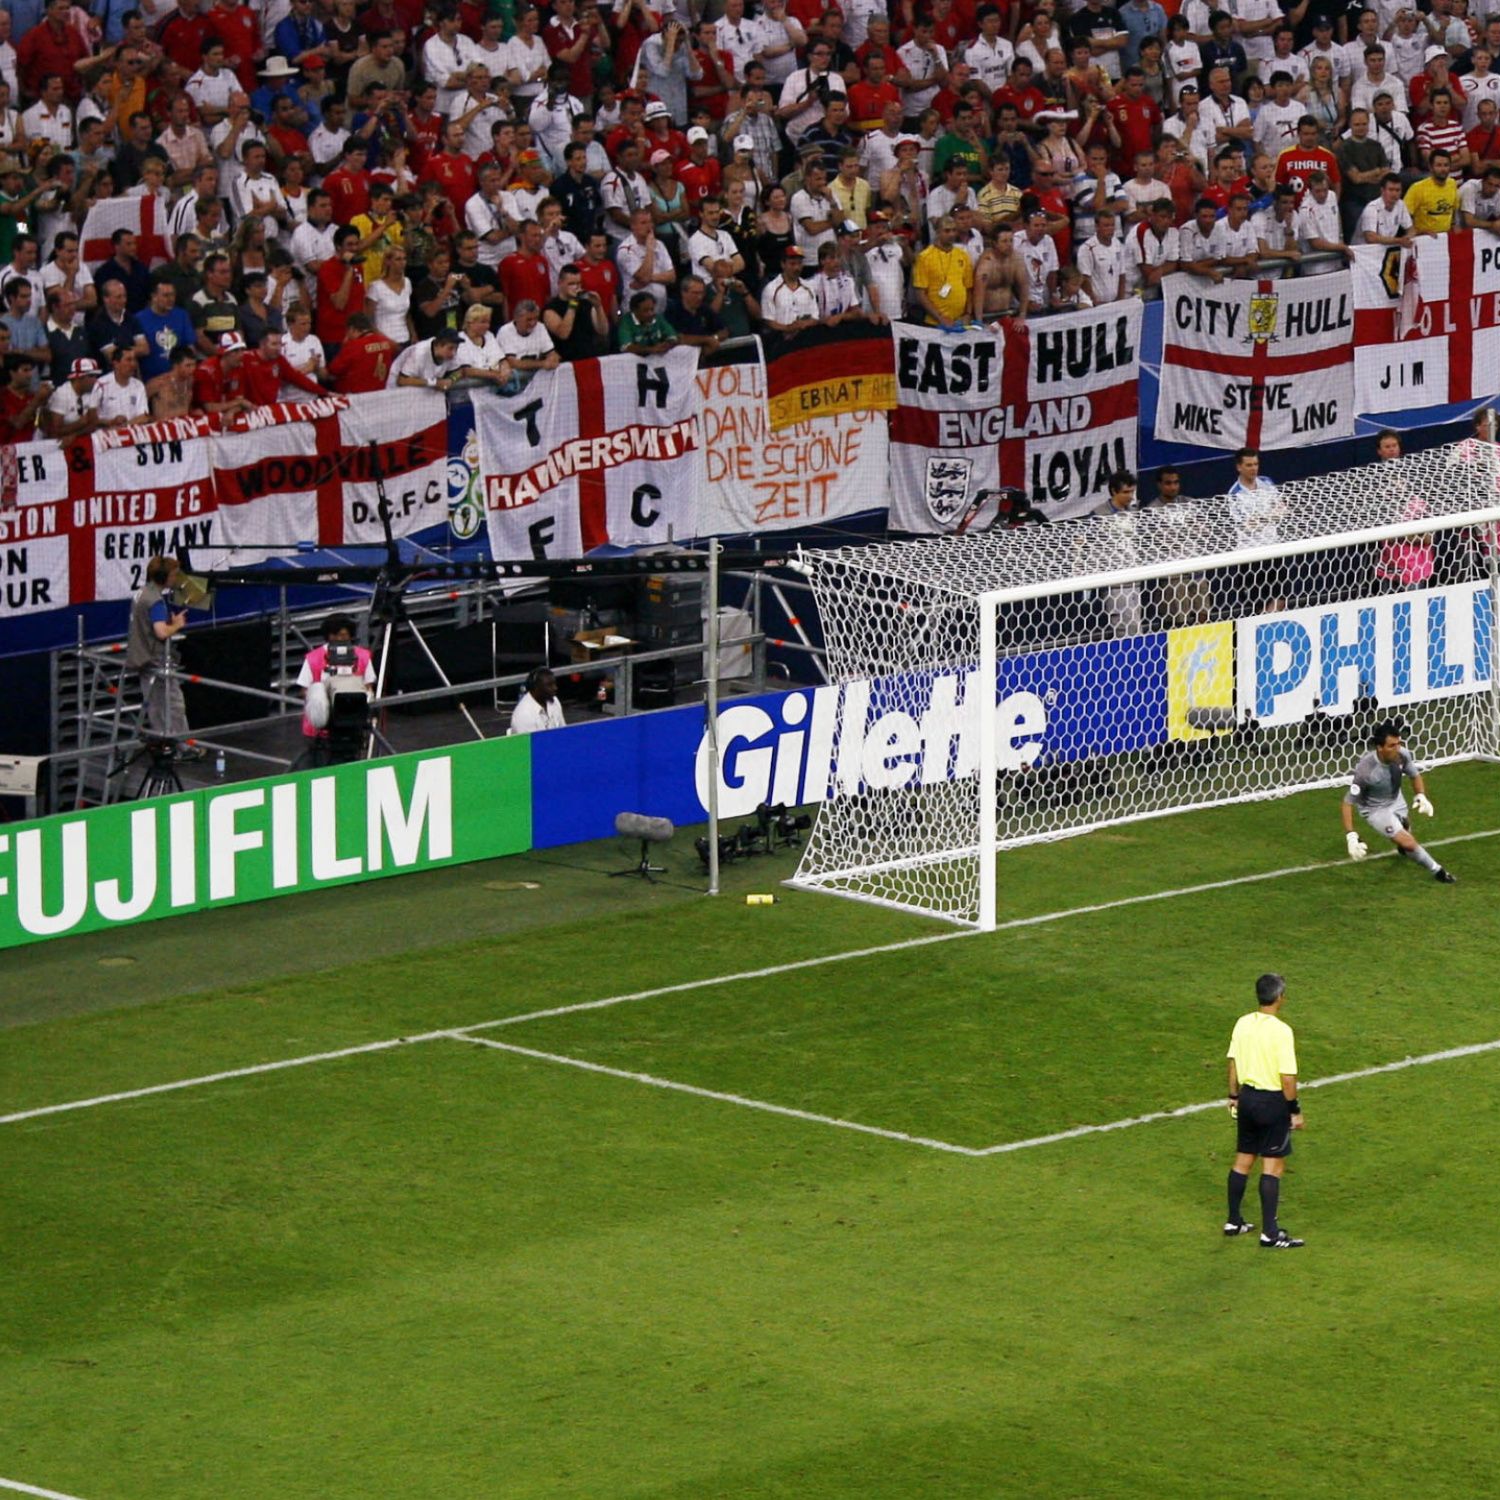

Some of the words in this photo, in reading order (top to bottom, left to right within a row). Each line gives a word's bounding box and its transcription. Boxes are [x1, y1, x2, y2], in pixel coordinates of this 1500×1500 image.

[1286, 160, 1328, 171] FINALE
[1175, 294, 1241, 338] CITY
[1286, 294, 1350, 338] HULL
[900, 337, 996, 394] EAST
[1037, 316, 1133, 384] HULL
[637, 363, 670, 409] H
[800, 379, 863, 411] EBNAT
[1223, 382, 1292, 411] STEVE
[939, 395, 1092, 447] ENGLAND
[1174, 402, 1223, 436] MIKE
[235, 434, 428, 498] WOODVILLE
[706, 445, 755, 483] DIE
[763, 428, 863, 477] SCHÖNE
[73, 493, 157, 528] UNITED
[175, 485, 201, 517] FC
[631, 484, 662, 527] C
[754, 472, 838, 524] ZEIT
[104, 519, 213, 561] GERMANY
[0, 578, 51, 609] UR
[695, 670, 1047, 820] Gillette
